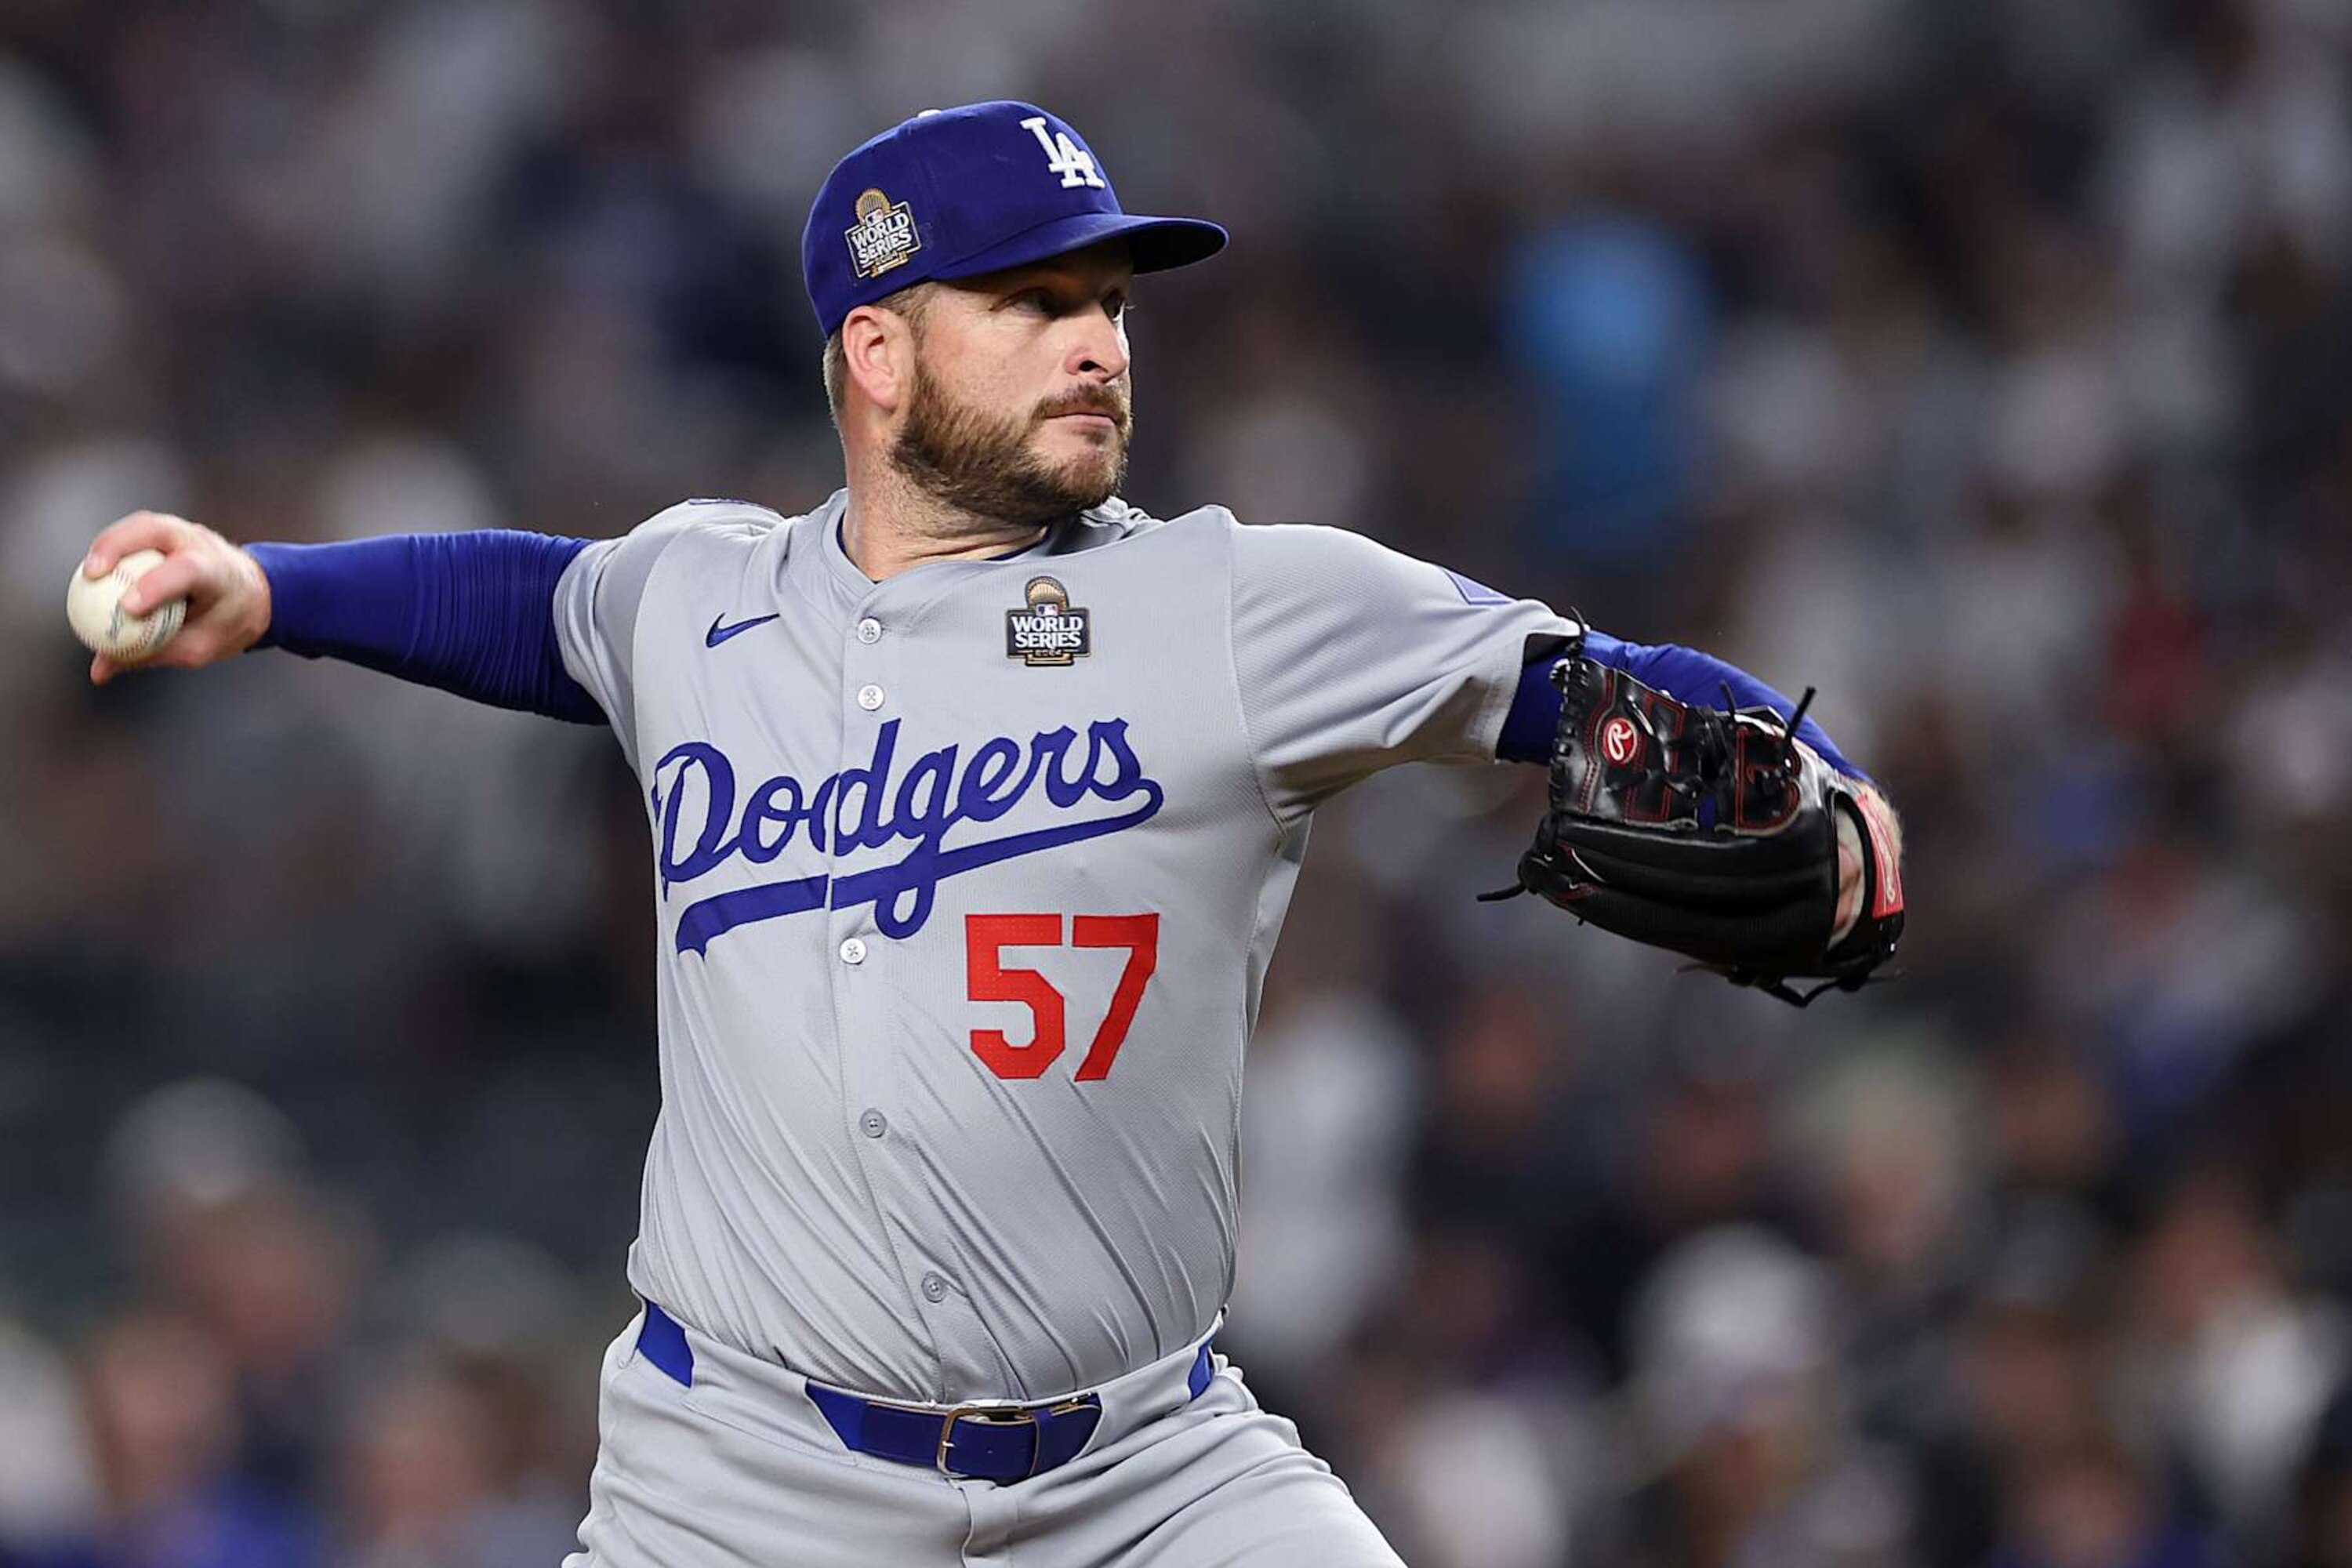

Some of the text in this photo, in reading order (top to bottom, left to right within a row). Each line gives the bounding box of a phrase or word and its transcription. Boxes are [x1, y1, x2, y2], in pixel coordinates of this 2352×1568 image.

[1020, 117, 1105, 188] LA
[851, 212, 909, 250] WORLD
[858, 228, 912, 264] SERIES
[1011, 616, 1083, 632] WORLD
[1014, 631, 1082, 649] SERIES
[652, 718, 1163, 961] Dodgers
[965, 913, 1159, 1081] 57
